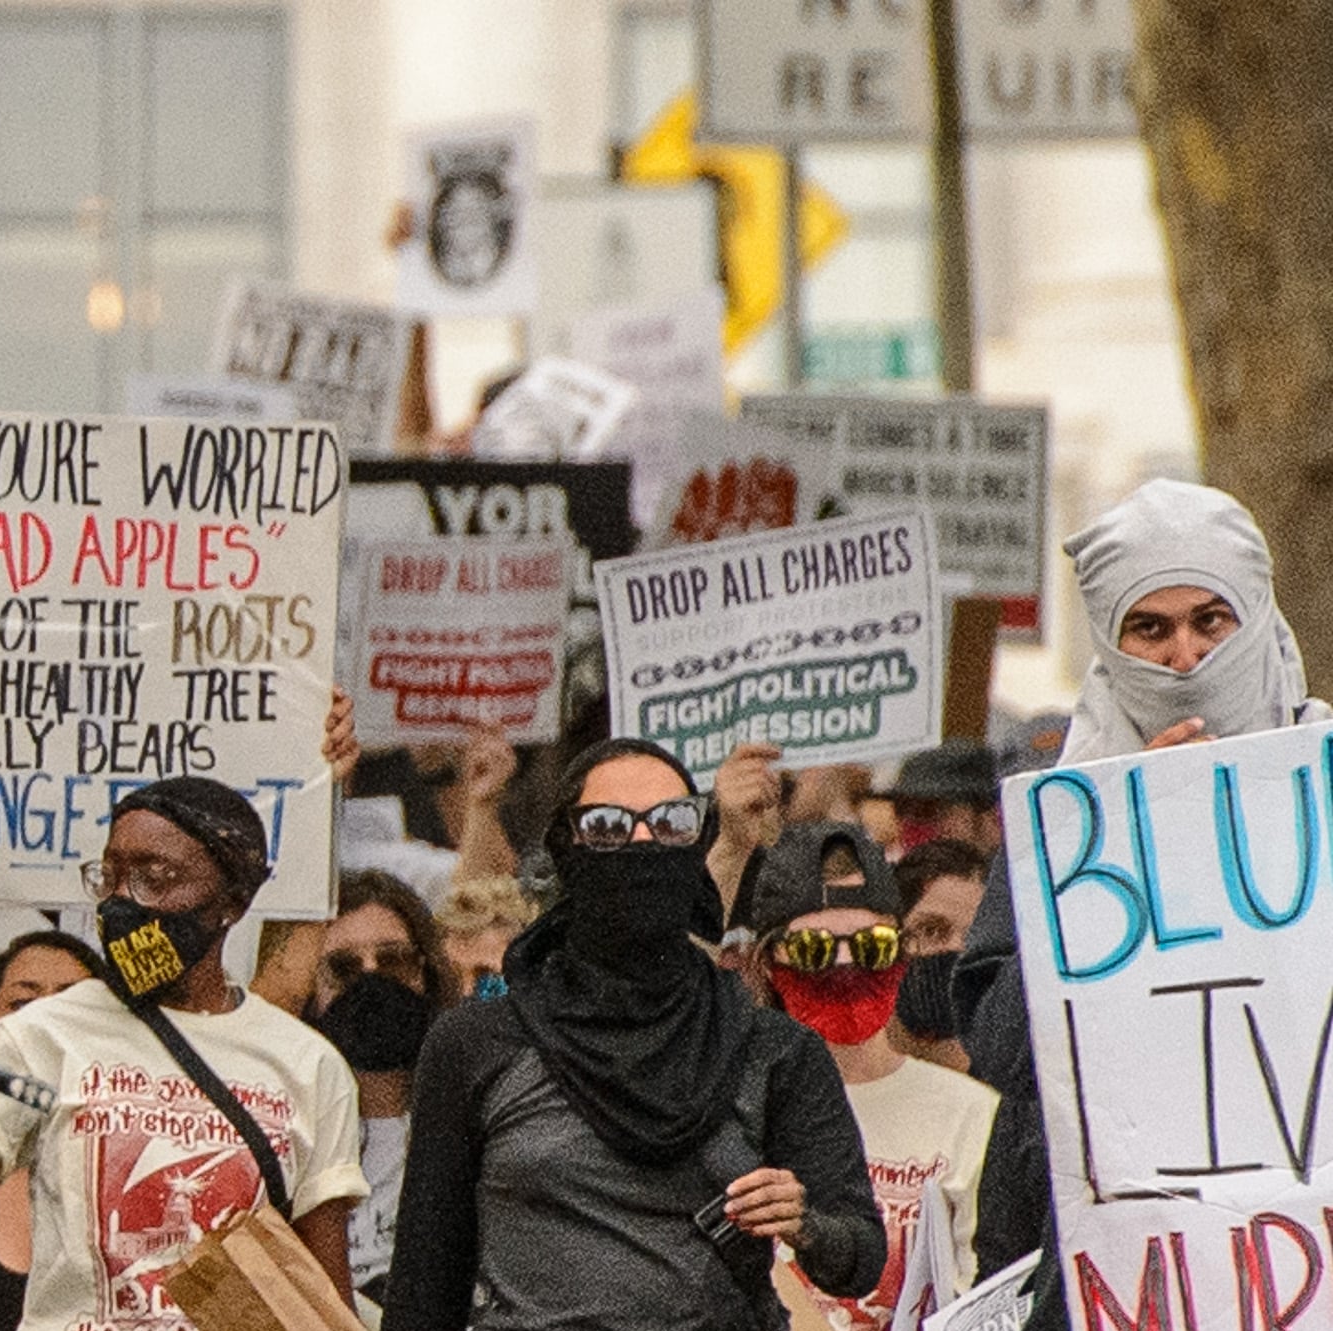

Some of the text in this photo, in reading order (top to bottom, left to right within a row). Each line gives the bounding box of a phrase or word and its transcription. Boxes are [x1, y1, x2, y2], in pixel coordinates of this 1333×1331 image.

[140, 424, 340, 525] WORRIED
[627, 566, 709, 624] DROP
[721, 556, 773, 609] ALL
[782, 525, 913, 596] CHARGES
[63, 599, 141, 659] THE
[170, 594, 316, 666] ROOTS
[0, 661, 144, 726] HEALTHY
[172, 669, 278, 723] TREE
[647, 656, 910, 734] FIGHT POLITICAL
[77, 718, 216, 780] BEARS
[684, 702, 872, 768] REPRESSION
[1024, 735, 1333, 983] BLU
[109, 918, 170, 962] BLACK
[83, 1064, 101, 1097] if
[107, 1068, 147, 1094] the
[144, 1109, 196, 1145] stop
